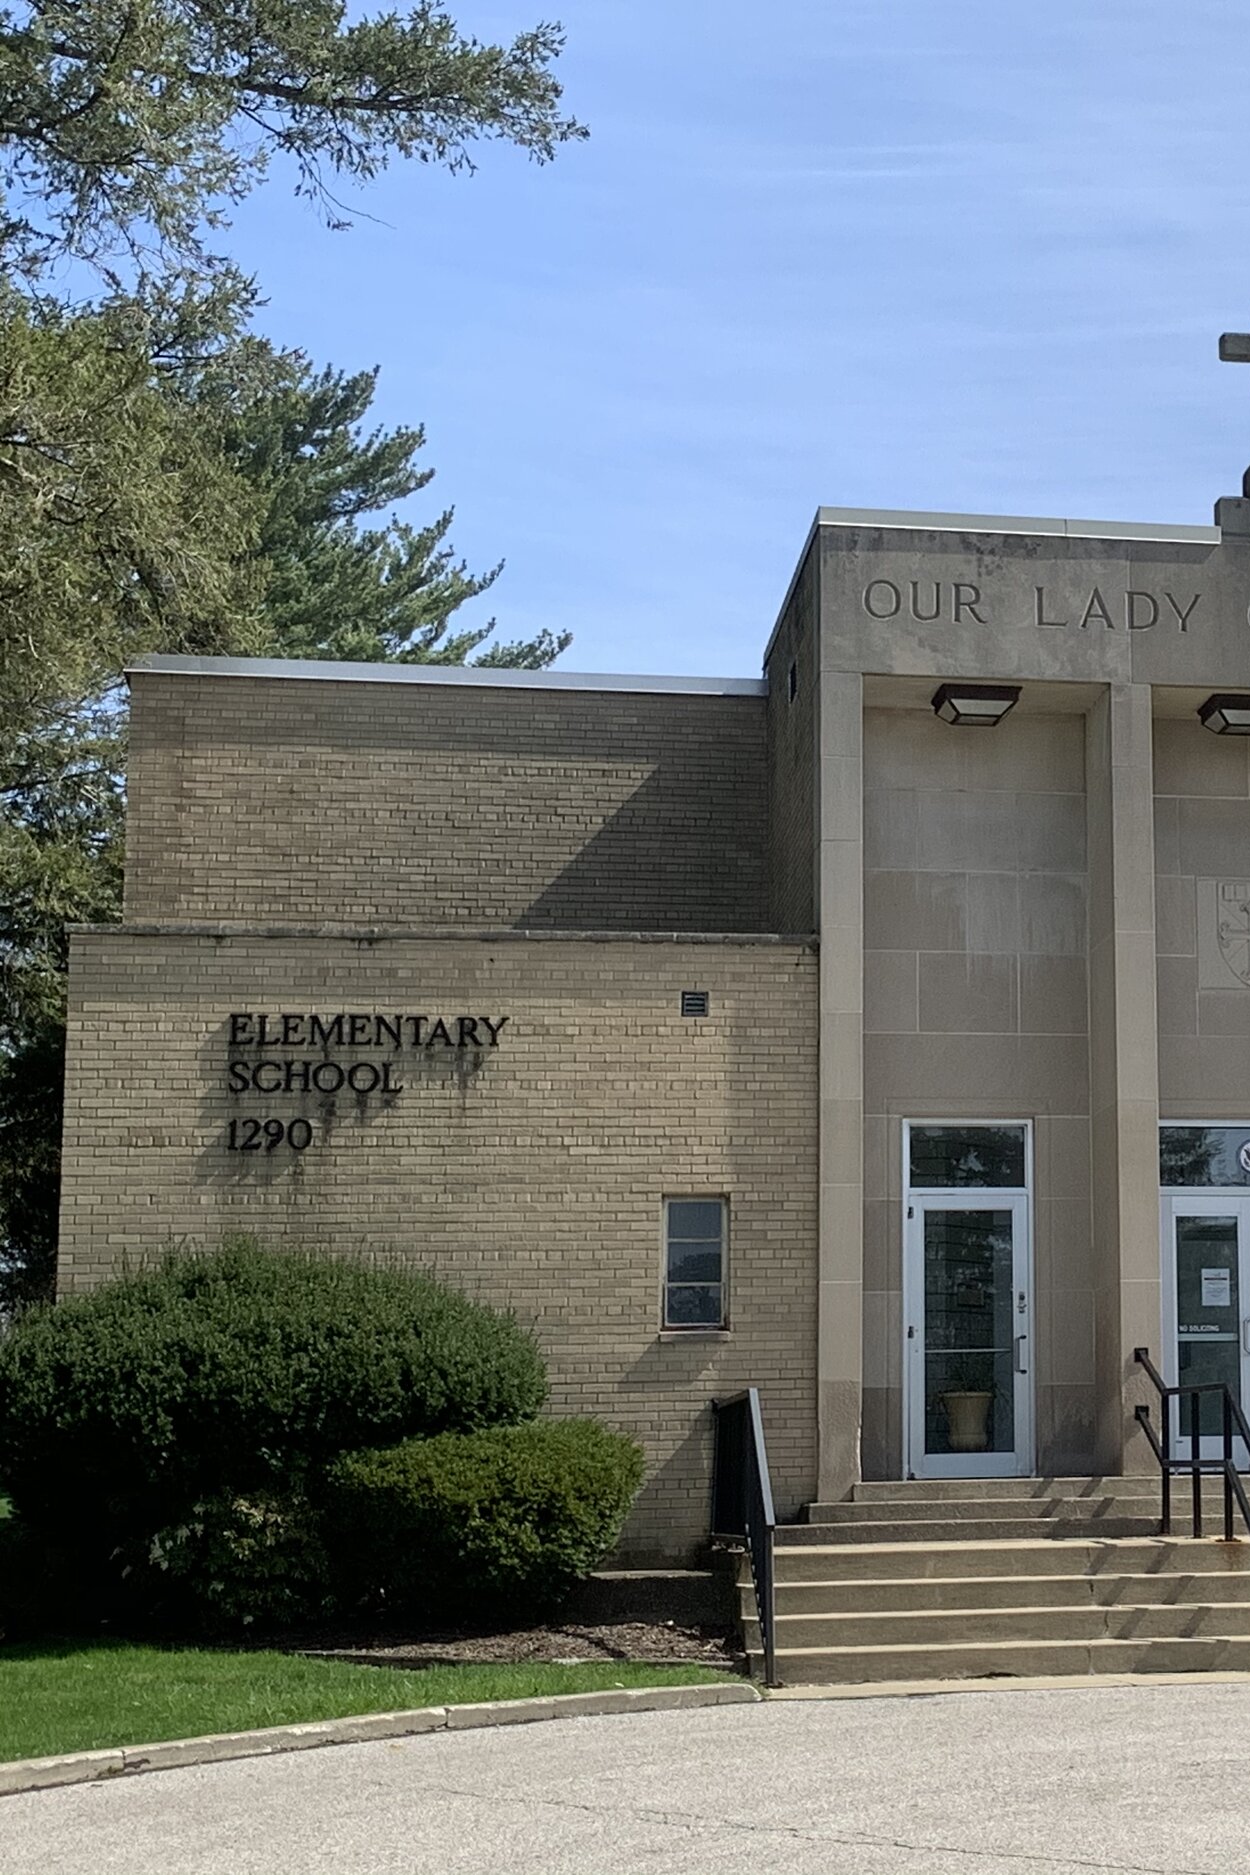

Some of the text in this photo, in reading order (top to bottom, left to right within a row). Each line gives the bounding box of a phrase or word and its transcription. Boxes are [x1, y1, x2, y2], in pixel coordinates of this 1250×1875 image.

[862, 579, 988, 625] OUR
[1034, 585, 1201, 633] LADY
[228, 1013, 510, 1049] ELEMENTARY
[228, 1060, 404, 1094] SCHOOL
[226, 1118, 313, 1151] 1290
